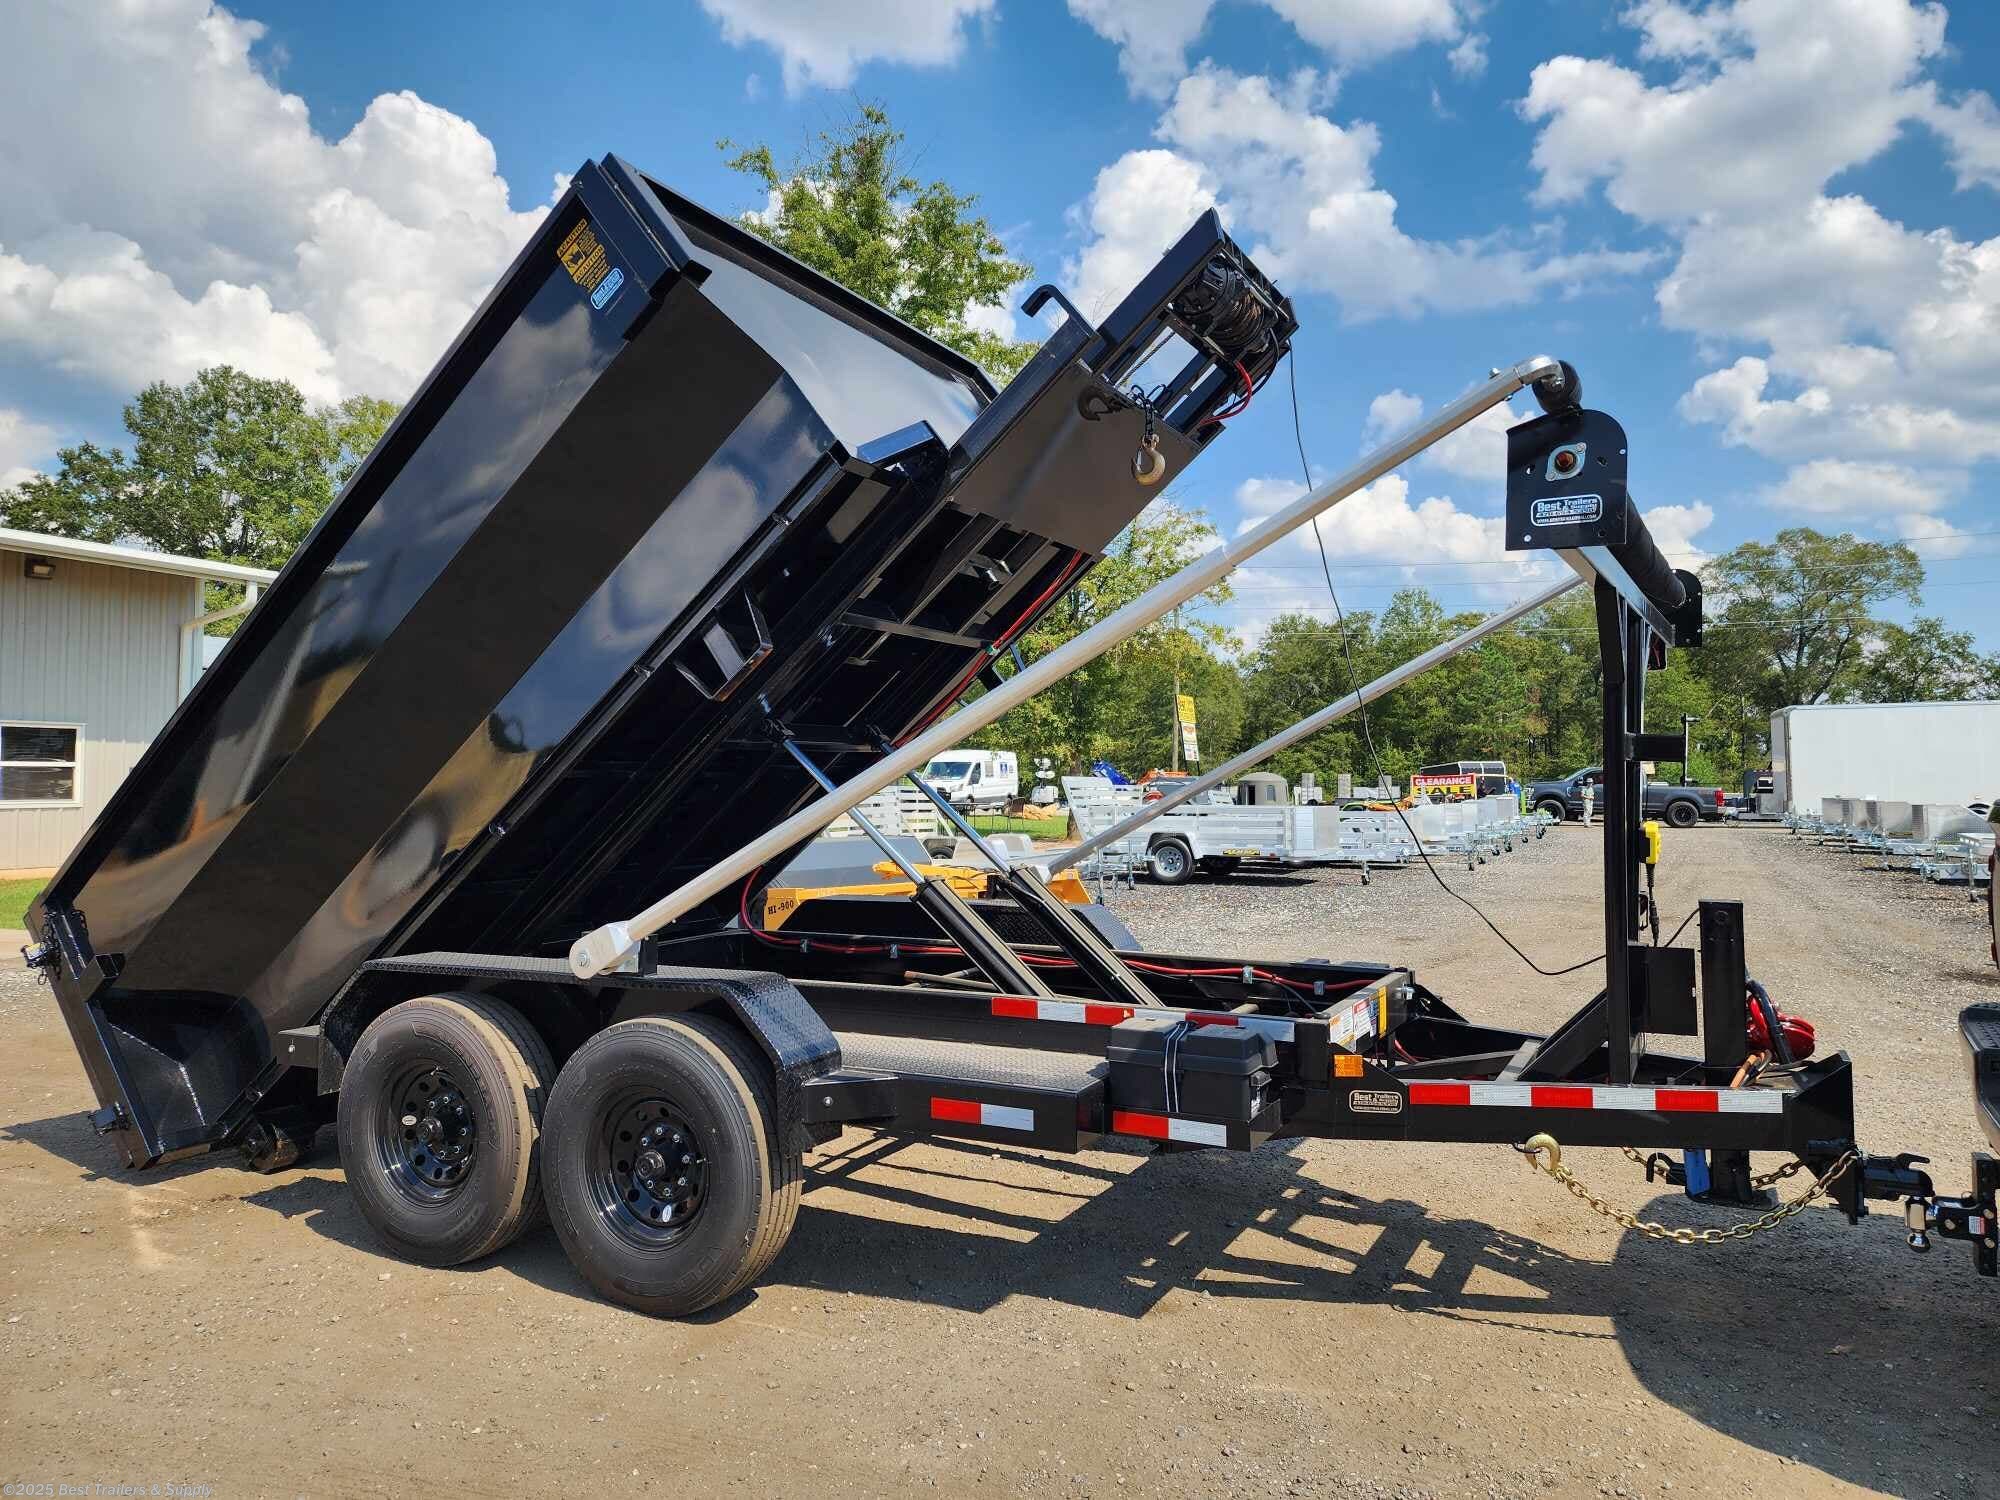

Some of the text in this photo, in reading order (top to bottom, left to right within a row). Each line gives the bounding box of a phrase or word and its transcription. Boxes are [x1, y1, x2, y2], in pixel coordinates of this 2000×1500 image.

[1537, 498, 1598, 512] Best Trailers
[1415, 776, 1472, 786] CLEARANCE
[1354, 1093, 1372, 1101] Best
